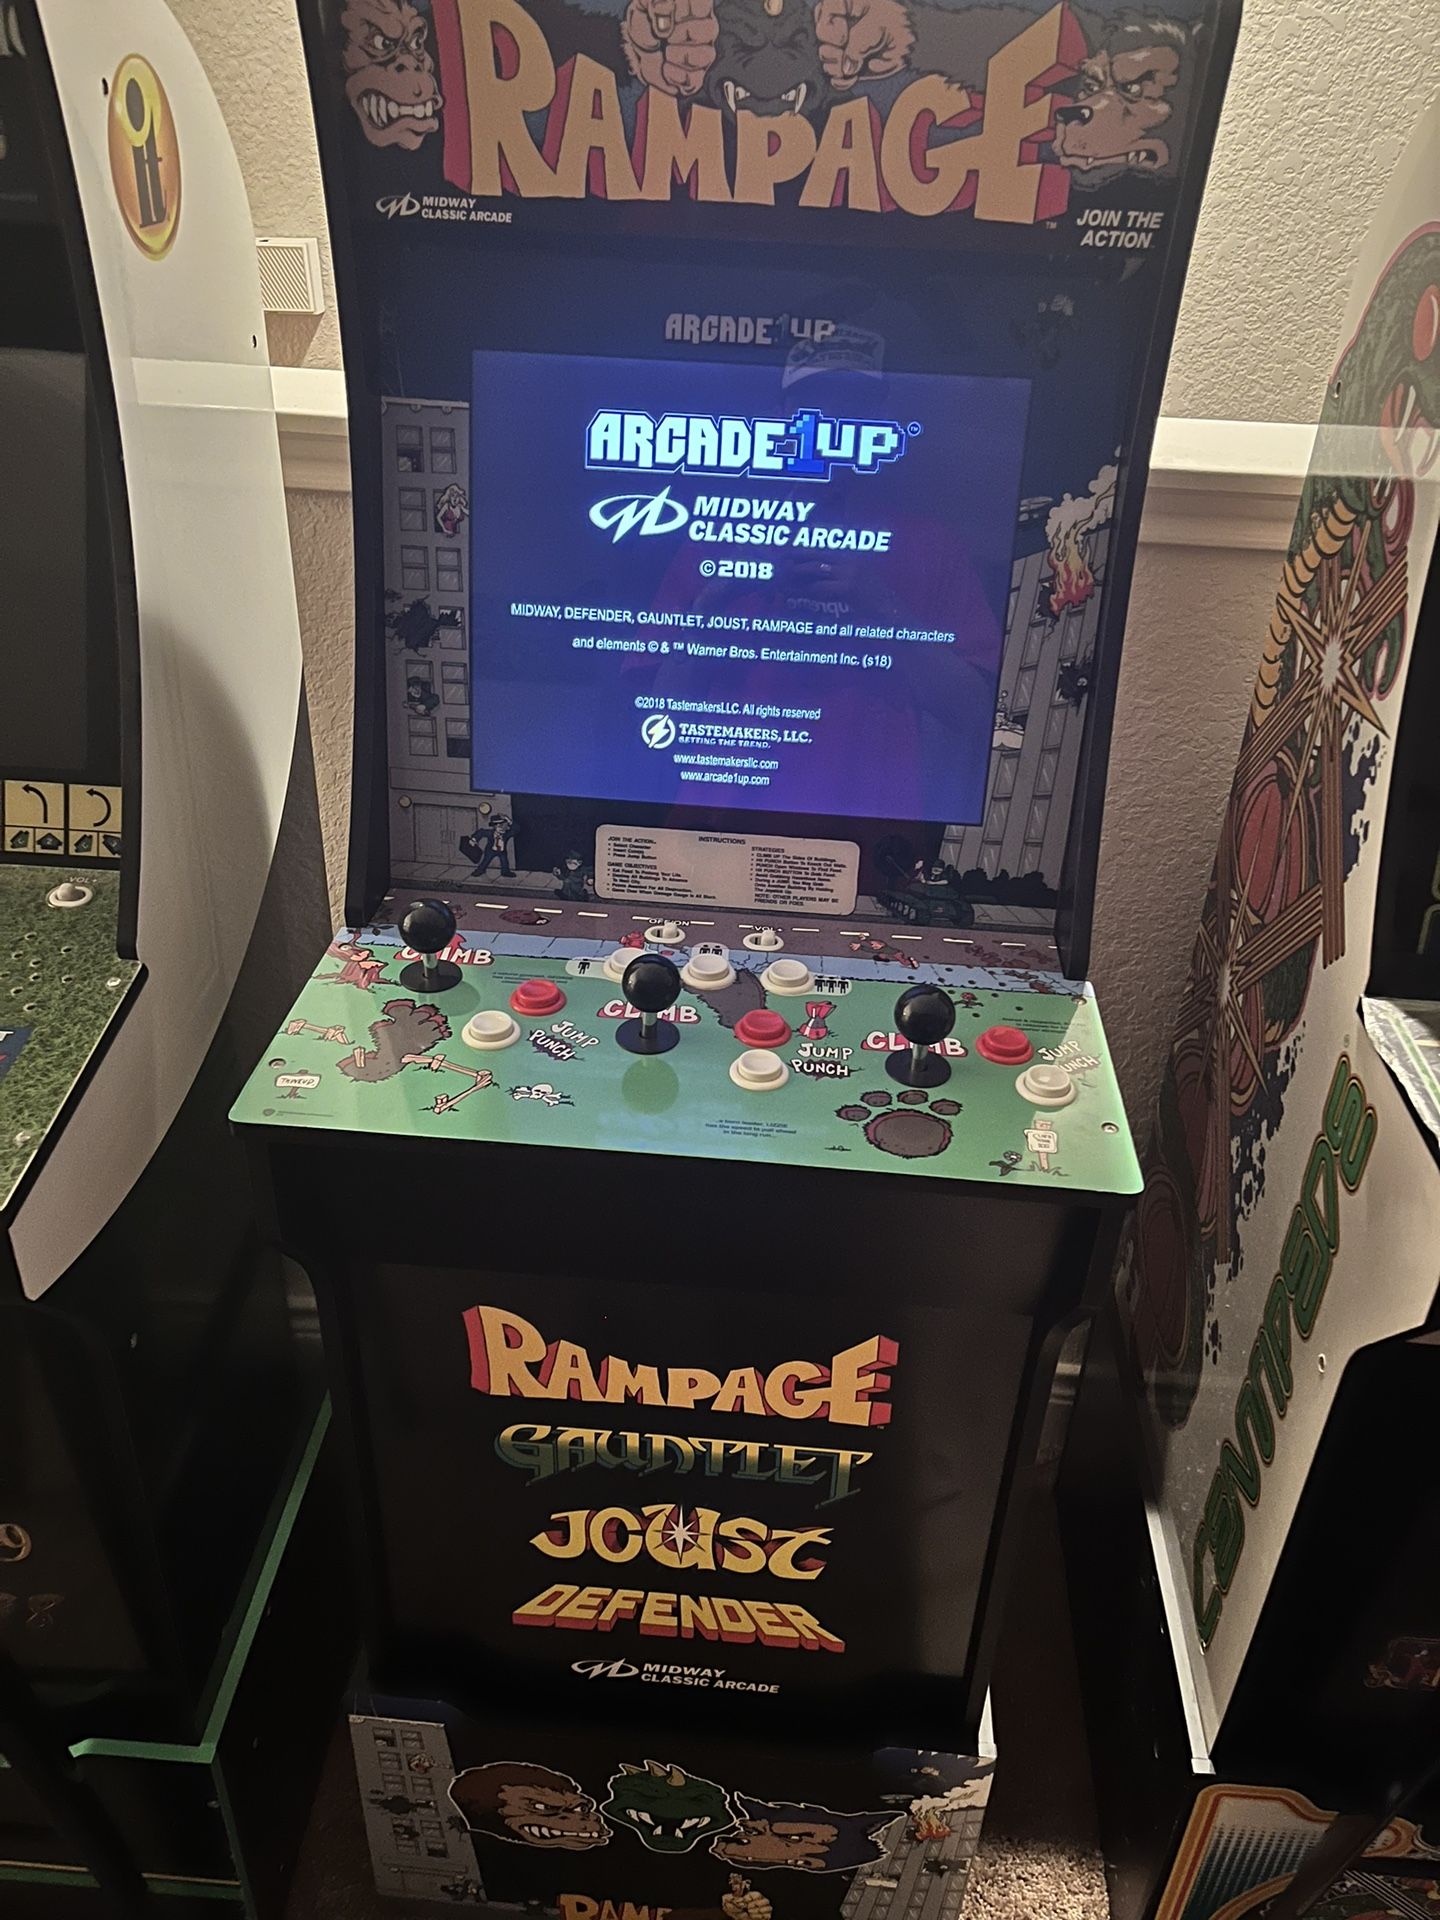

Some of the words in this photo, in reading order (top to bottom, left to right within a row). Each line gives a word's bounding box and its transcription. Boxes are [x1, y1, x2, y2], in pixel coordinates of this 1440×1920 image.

[440, 0, 1090, 226] RAMPAGE
[422, 196, 477, 208] MIDWAY
[421, 208, 466, 220] CLASSIC
[469, 211, 513, 223] ARCADE
[1076, 209, 1122, 227] JOIN
[1127, 211, 1164, 229] THE
[1080, 230, 1153, 249] ACTION
[586, 409, 905, 482] ARCADE1UP
[693, 496, 816, 521] MIDWAY
[689, 520, 790, 546] CLASSIC
[793, 526, 892, 552] ARCADE
[510, 602, 562, 620] MIDWAY,
[564, 606, 636, 624] DEFENDER,
[637, 611, 705, 629] GAUNTLET,
[707, 615, 750, 631] JOUST,
[752, 619, 814, 636] RAMPAGE
[815, 624, 837, 636] and
[839, 624, 853, 637] all
[855, 626, 894, 639] related
[896, 629, 955, 643] characters
[572, 636, 594, 648] and
[596, 637, 646, 652] elements
[660, 641, 670, 653] &
[687, 643, 728, 658] Warner
[729, 646, 759, 659] Bros.
[760, 648, 838, 664] Entertainment
[840, 652, 860, 666] Inc.
[862, 654, 892, 670] (s18)
[742, 703, 755, 714] All
[756, 704, 780, 719] rights
[782, 708, 822, 720] reserved
[679, 722, 782, 742] TASTEMAKERS,
[783, 730, 812, 744] LLC.
[718, 738, 736, 747] THE
[680, 770, 770, 786] www.arcade1up.com
[698, 836, 746, 845] INSTRUCTIONS
[401, 945, 492, 965] CIMB
[603, 999, 698, 1022] CLMB
[529, 1029, 577, 1060] PUNCH
[552, 1020, 600, 1048] JUMP
[866, 1031, 966, 1055] CLMB
[797, 1042, 854, 1060] JUMP
[1038, 1040, 1082, 1060] JUMP
[790, 1059, 850, 1076] PUNCH
[1059, 1056, 1099, 1073] UNCH
[462, 1305, 900, 1428] RAMPAGE
[494, 1422, 874, 1510] GAUNTLET
[529, 1503, 835, 1581] JOUST
[512, 1583, 846, 1653] DEFENDER
[643, 1662, 726, 1678] MIDWAY
[640, 1673, 710, 1686] CLASSIC
[714, 1680, 780, 1694] ARCADE
